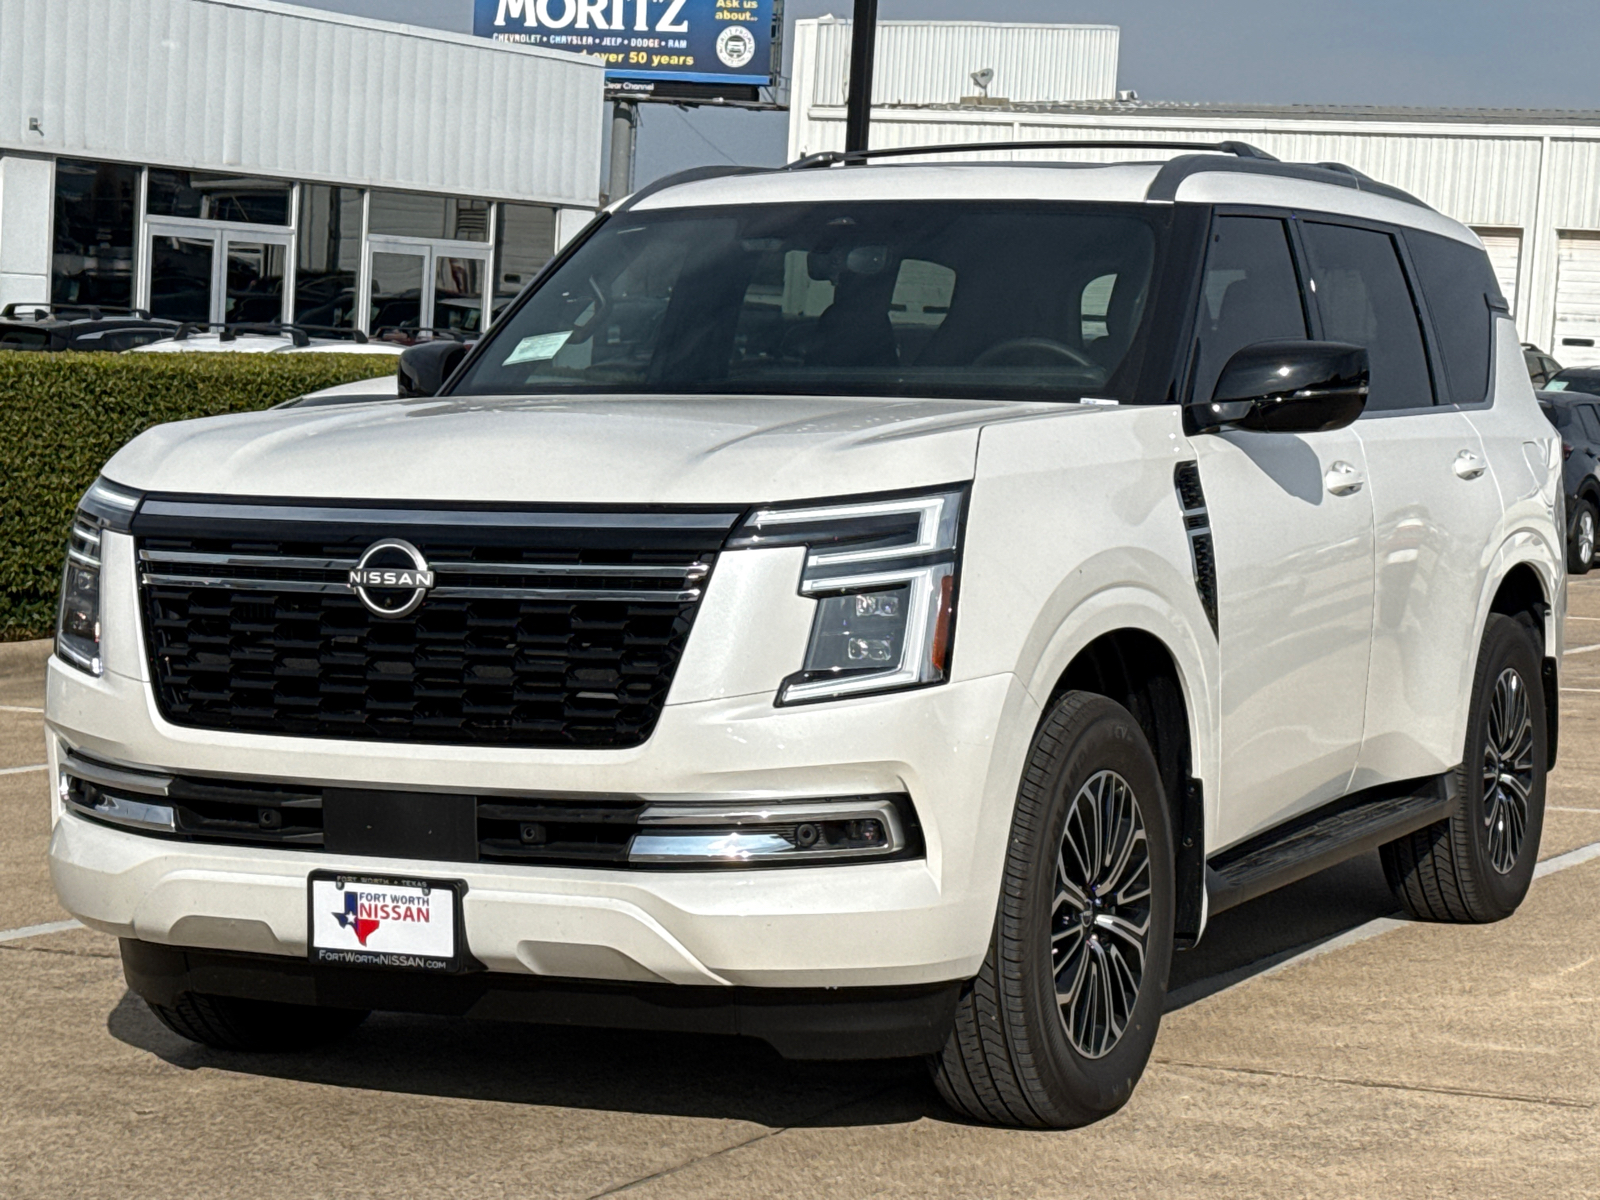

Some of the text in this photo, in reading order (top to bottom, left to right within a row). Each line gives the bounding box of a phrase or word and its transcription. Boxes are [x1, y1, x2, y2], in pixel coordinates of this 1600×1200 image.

[716, 0, 758, 9] Ask us
[493, 0, 689, 33] MORITZ
[493, 33, 688, 49] CHEVROLET CHRYSLER JEEP DODGE RAM
[628, 51, 648, 64] 50
[651, 54, 694, 67] years
[622, 82, 655, 91] Channel
[349, 570, 431, 586] NISSAN
[336, 875, 428, 888] FORT WORTH TEXAS
[359, 892, 430, 907] FORT WORTH
[359, 903, 430, 923] NISSAN
